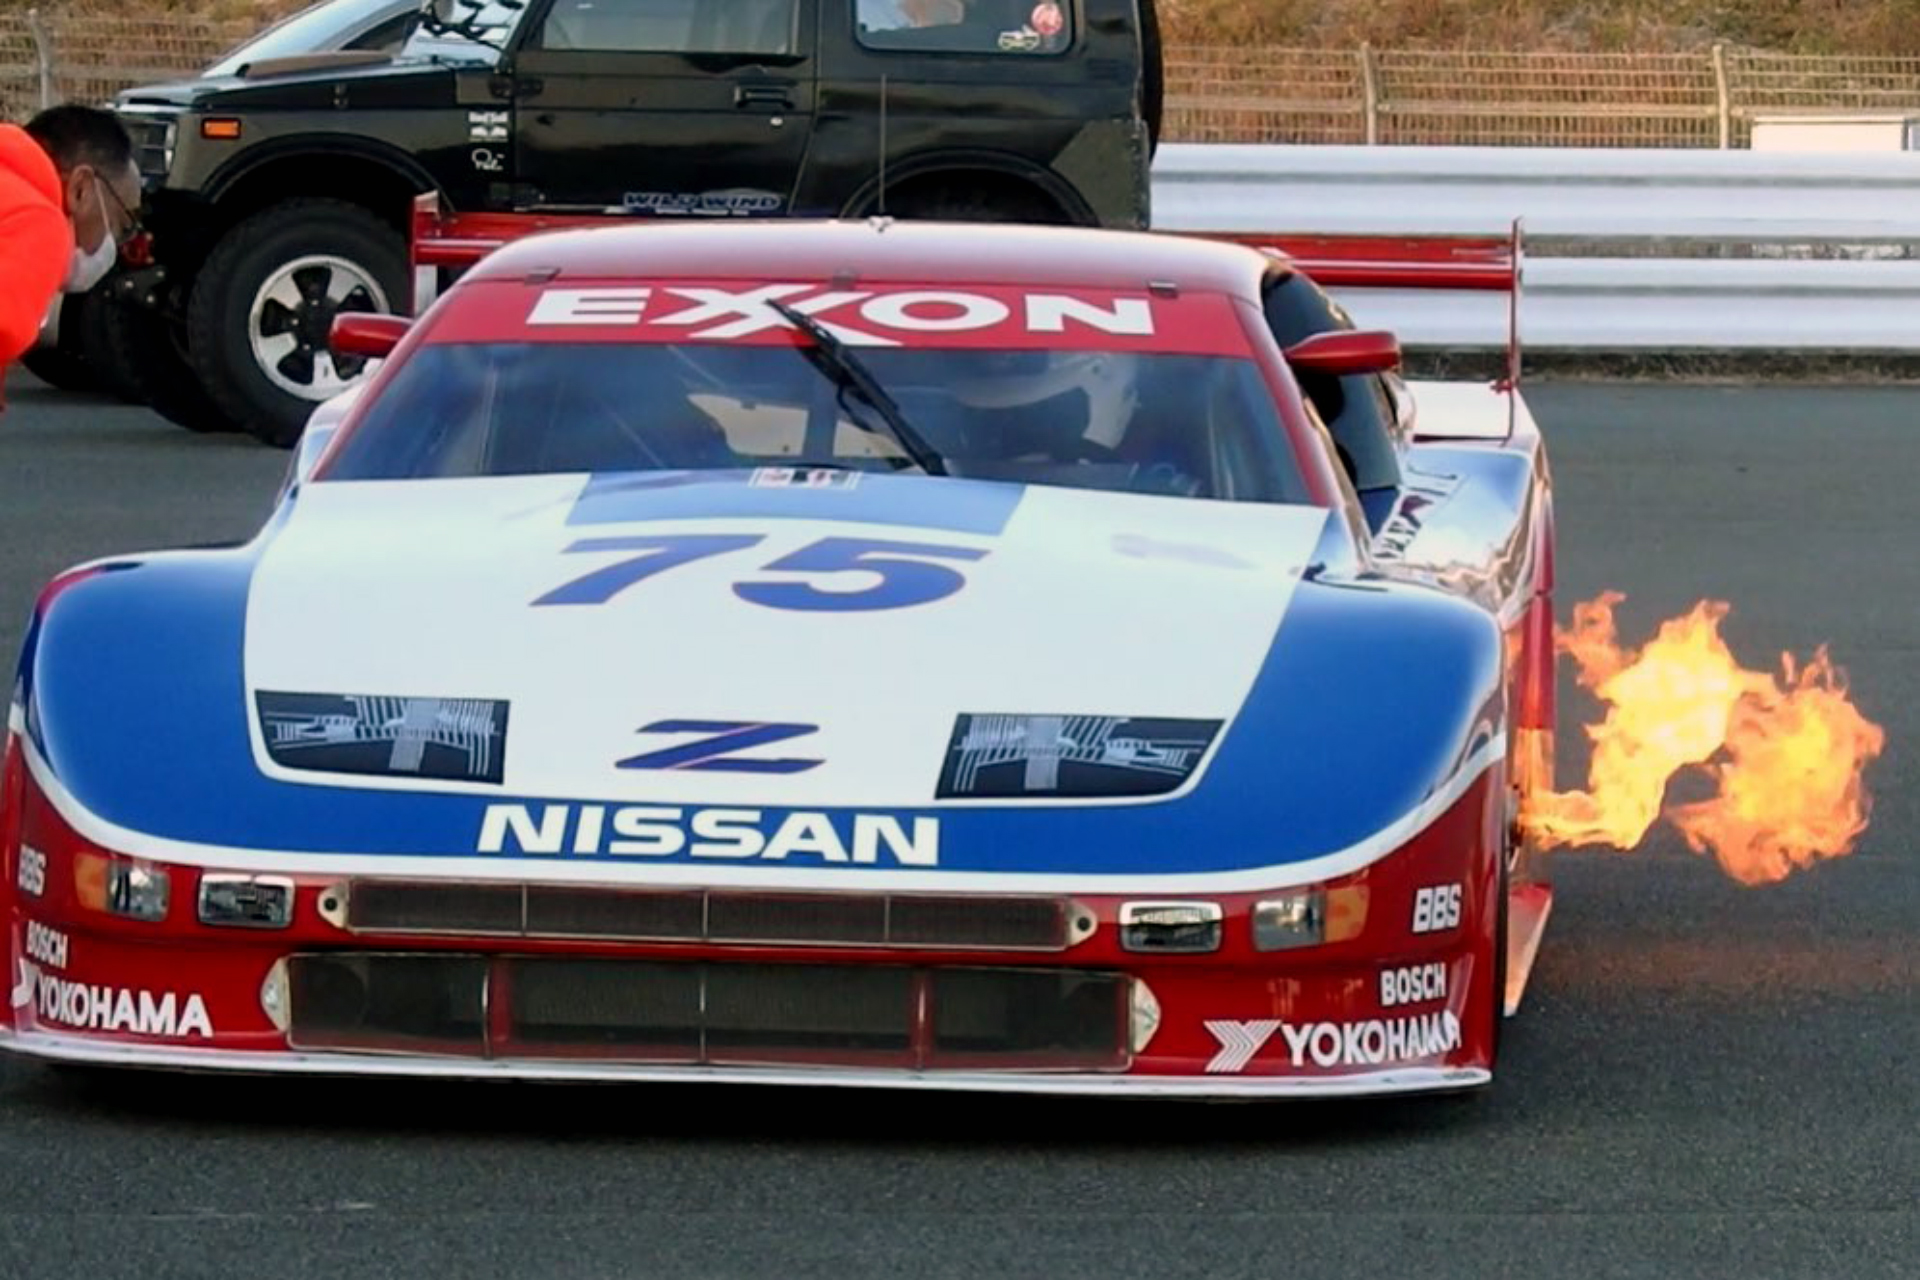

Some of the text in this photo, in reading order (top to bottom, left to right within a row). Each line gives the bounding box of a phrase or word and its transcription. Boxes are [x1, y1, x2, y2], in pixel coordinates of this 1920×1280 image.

[525, 284, 1155, 346] EXXON
[527, 533, 991, 612] 75
[614, 718, 827, 775] Z
[476, 804, 940, 867] NISSAN
[18, 843, 47, 897] BBS
[1412, 882, 1463, 934] BBS
[26, 919, 69, 970] BOSCH
[38, 972, 214, 1039] YOKOHAMA
[1380, 962, 1446, 1007] BOSCH
[1281, 1009, 1462, 1068] YOKOHAMA
